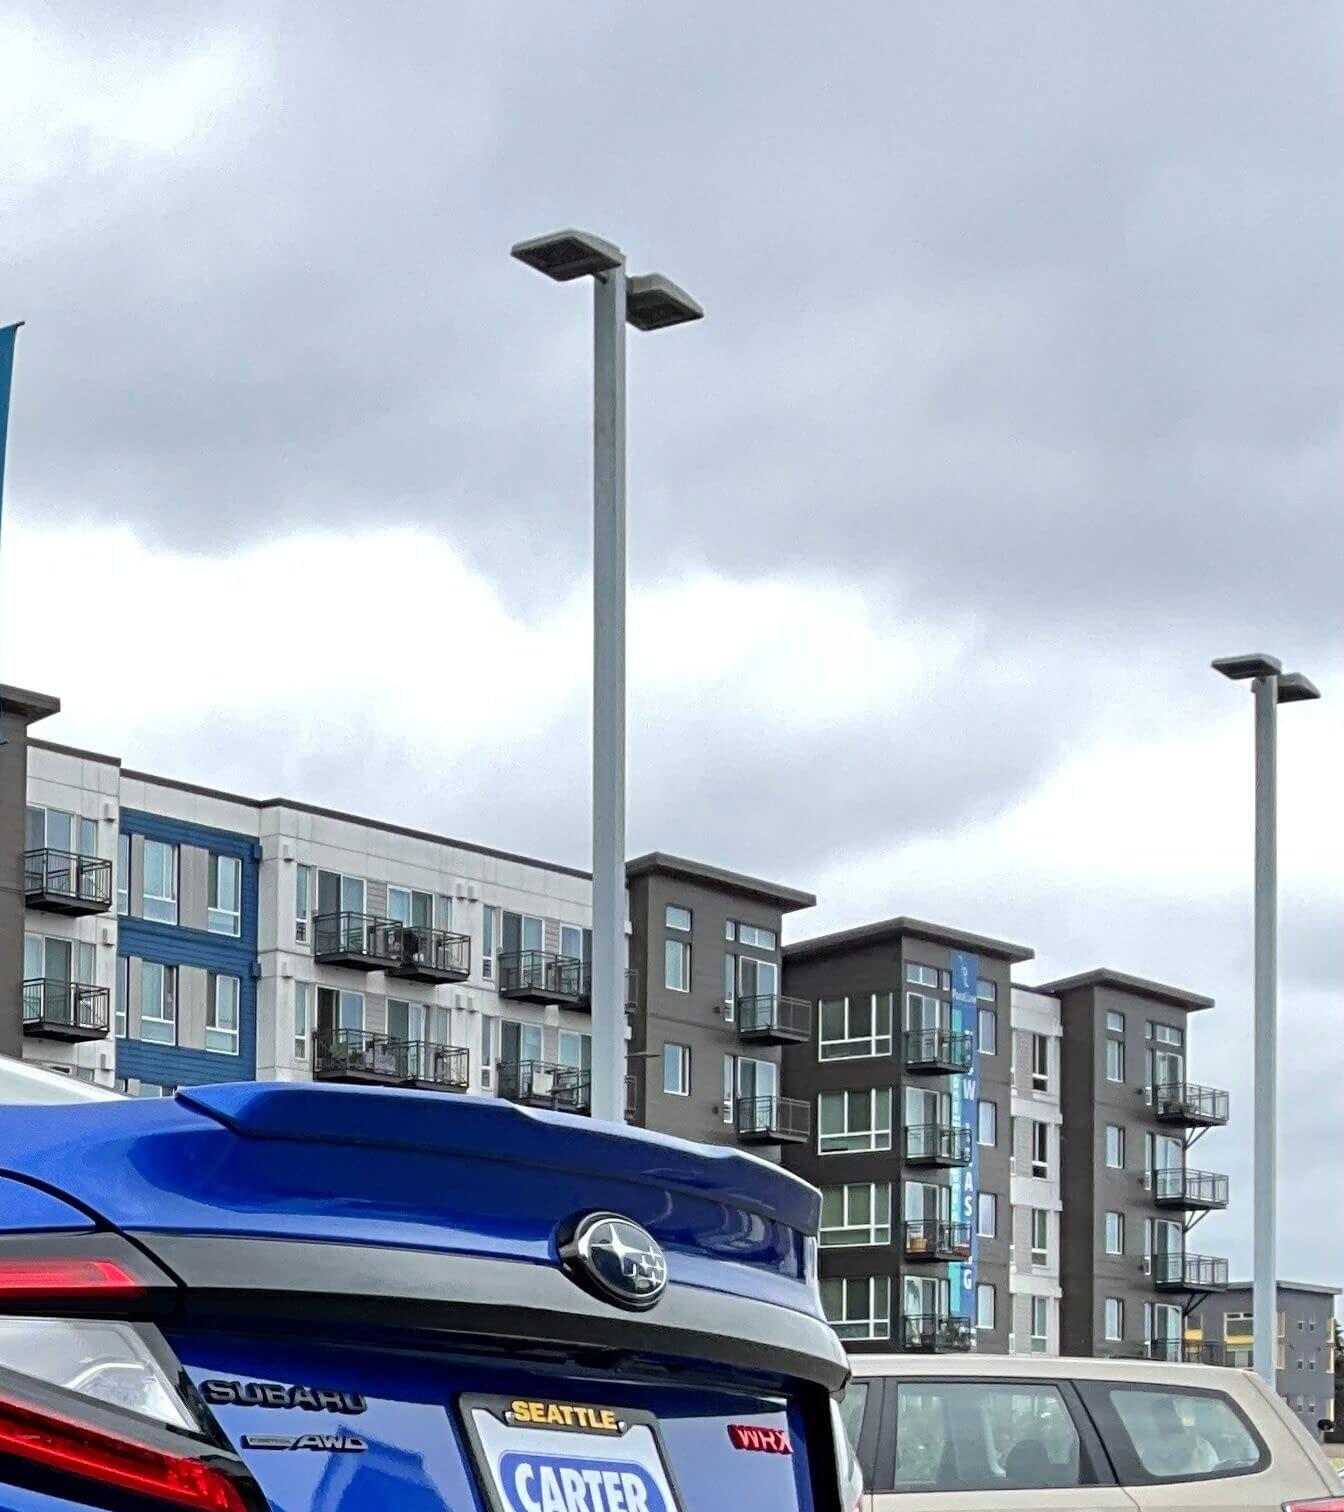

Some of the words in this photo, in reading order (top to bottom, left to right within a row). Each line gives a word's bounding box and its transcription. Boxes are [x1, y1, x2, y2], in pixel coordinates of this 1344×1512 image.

[200, 1379, 368, 1415] SUBARU
[511, 1400, 617, 1431] SEATTLE
[296, 1434, 369, 1450] AWD
[730, 1424, 794, 1454] WRX
